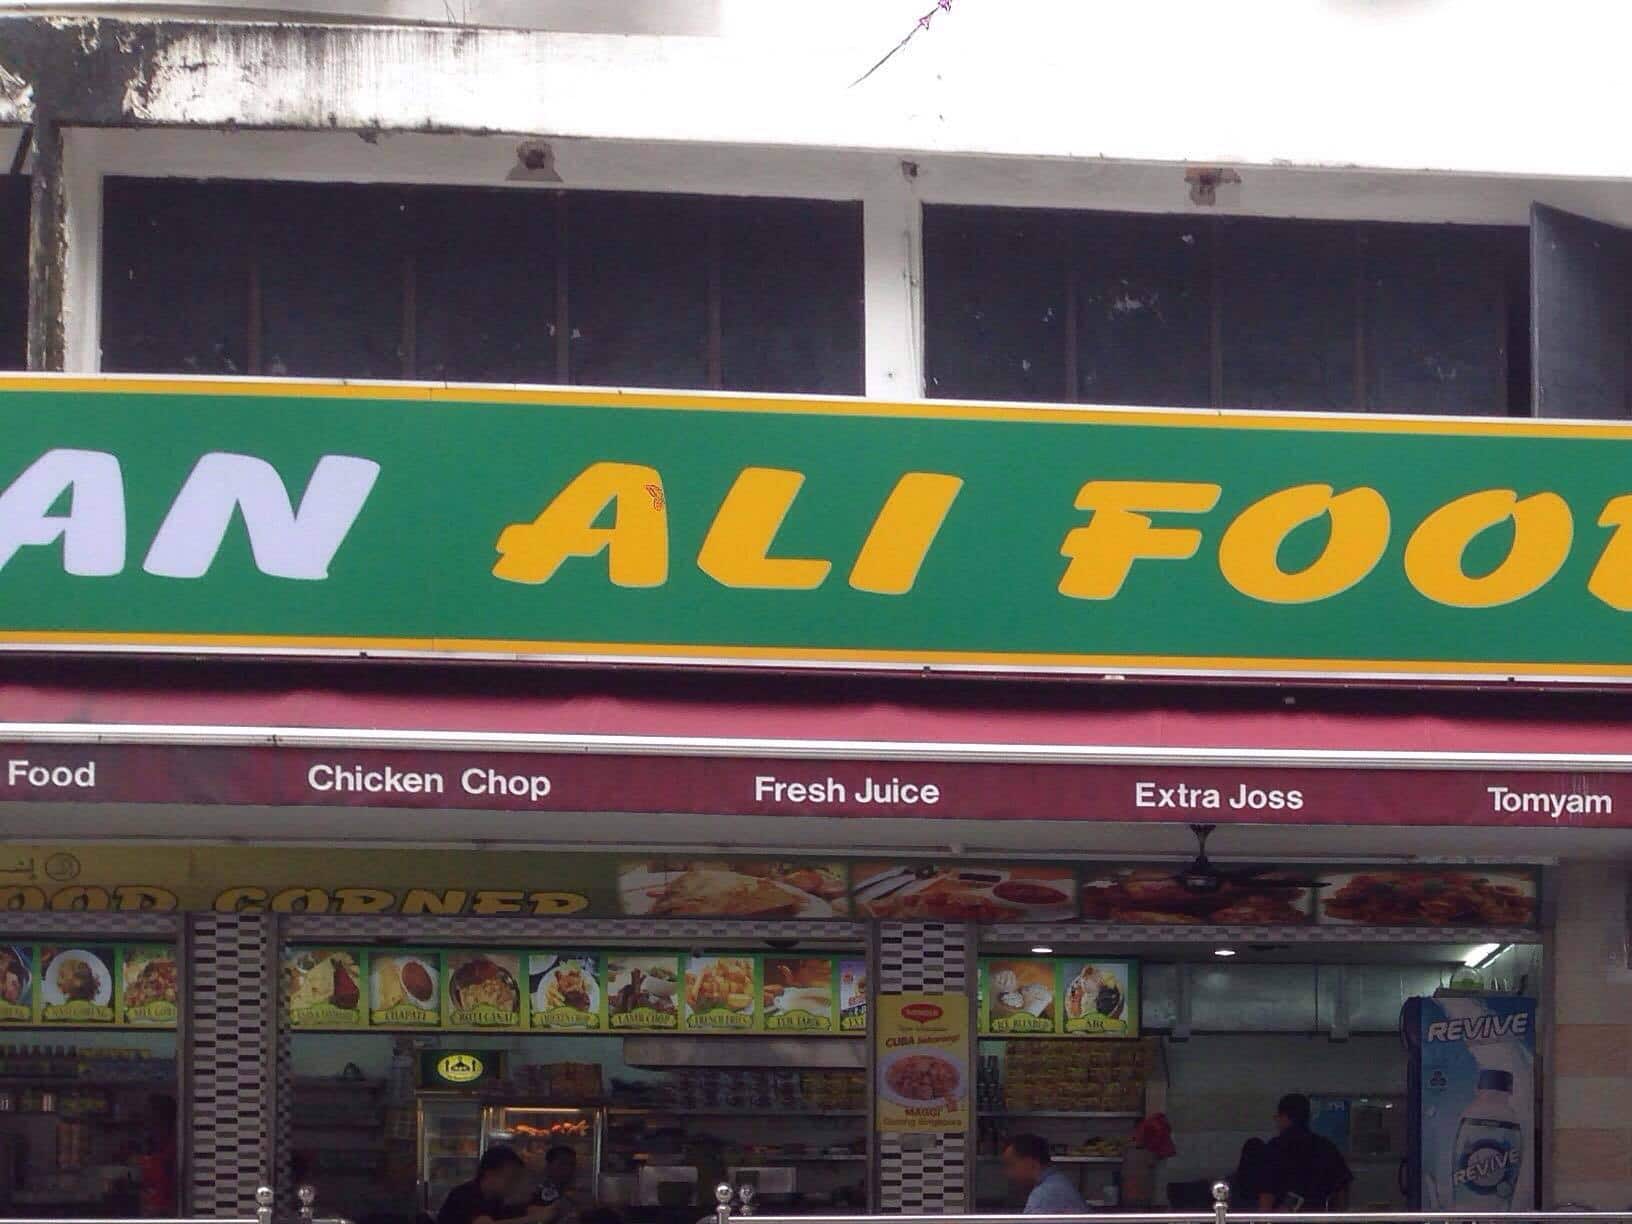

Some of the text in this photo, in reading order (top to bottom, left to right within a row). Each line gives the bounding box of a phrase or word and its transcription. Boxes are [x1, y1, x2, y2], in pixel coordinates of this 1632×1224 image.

[0, 449, 380, 580] AN
[493, 462, 960, 592] ALI
[9, 760, 95, 786] Food
[309, 765, 551, 801] Chicken Chop
[756, 776, 939, 803] Fresh Juice
[1136, 783, 1303, 809] Extra Joss
[1488, 787, 1611, 818] Tomyam
[1427, 1012, 1528, 1042] REVIVE
[1453, 1149, 1520, 1185] REVIVE
